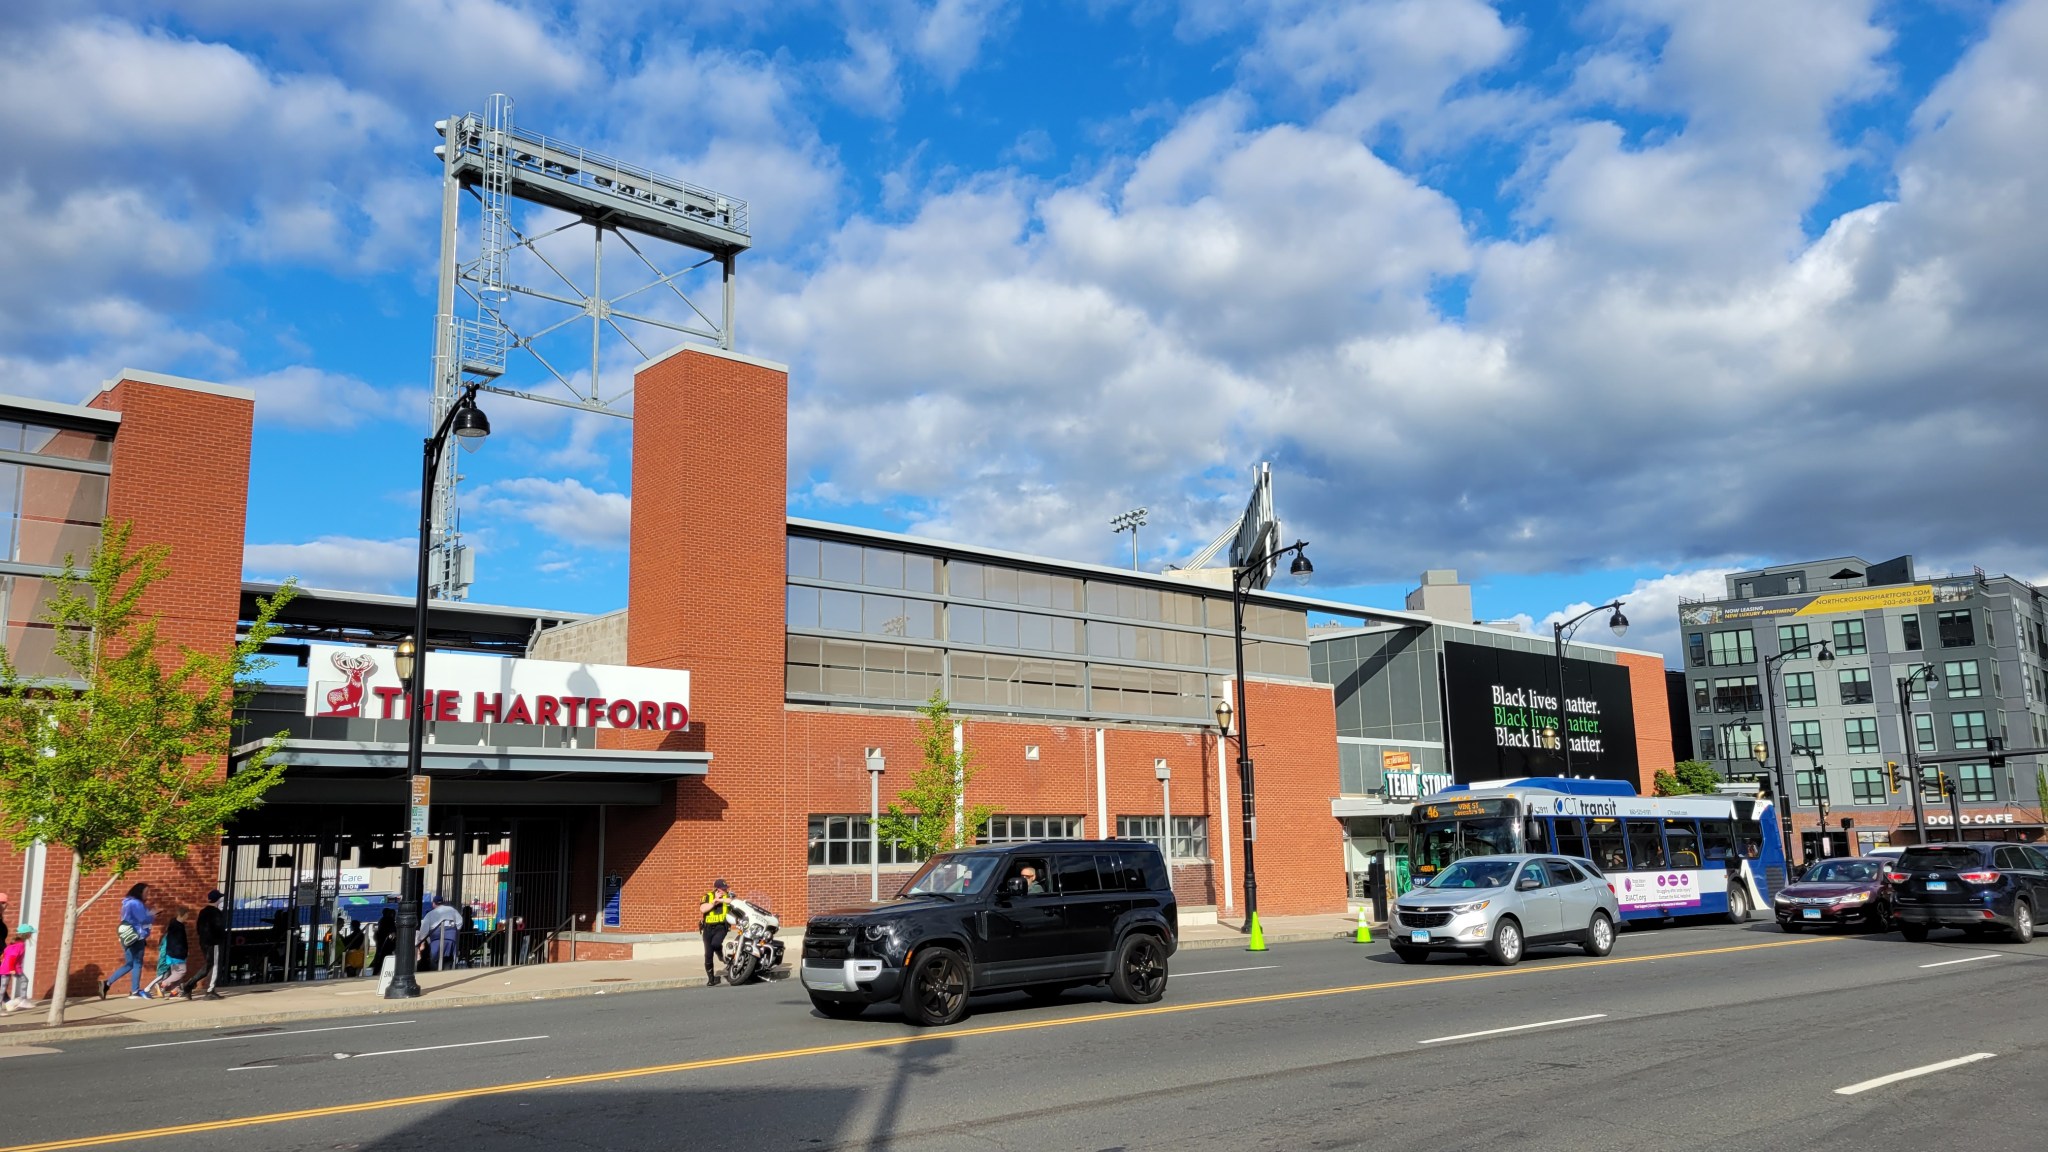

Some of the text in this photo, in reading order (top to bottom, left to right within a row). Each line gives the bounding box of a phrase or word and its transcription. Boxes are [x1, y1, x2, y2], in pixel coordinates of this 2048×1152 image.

[1816, 590, 1930, 605] NORTHCROSSINGHARTFORD.COM
[1740, 605, 1764, 613] LEASING
[1761, 607, 1798, 616] APARTMENTS
[1491, 685, 1527, 707] Black
[1528, 689, 1558, 710] lives
[372, 686, 689, 732] THE HARTFORD
[1493, 706, 1528, 727] Black
[1530, 709, 1559, 730] lives
[1494, 727, 1530, 748] Black
[1531, 729, 1561, 750] lis
[1386, 773, 1419, 796] TEAM
[1427, 805, 1439, 818] 46
[1471, 801, 1479, 809] ST
[1564, 797, 1617, 815] CT transit
[1974, 813, 2014, 824] CAFE
